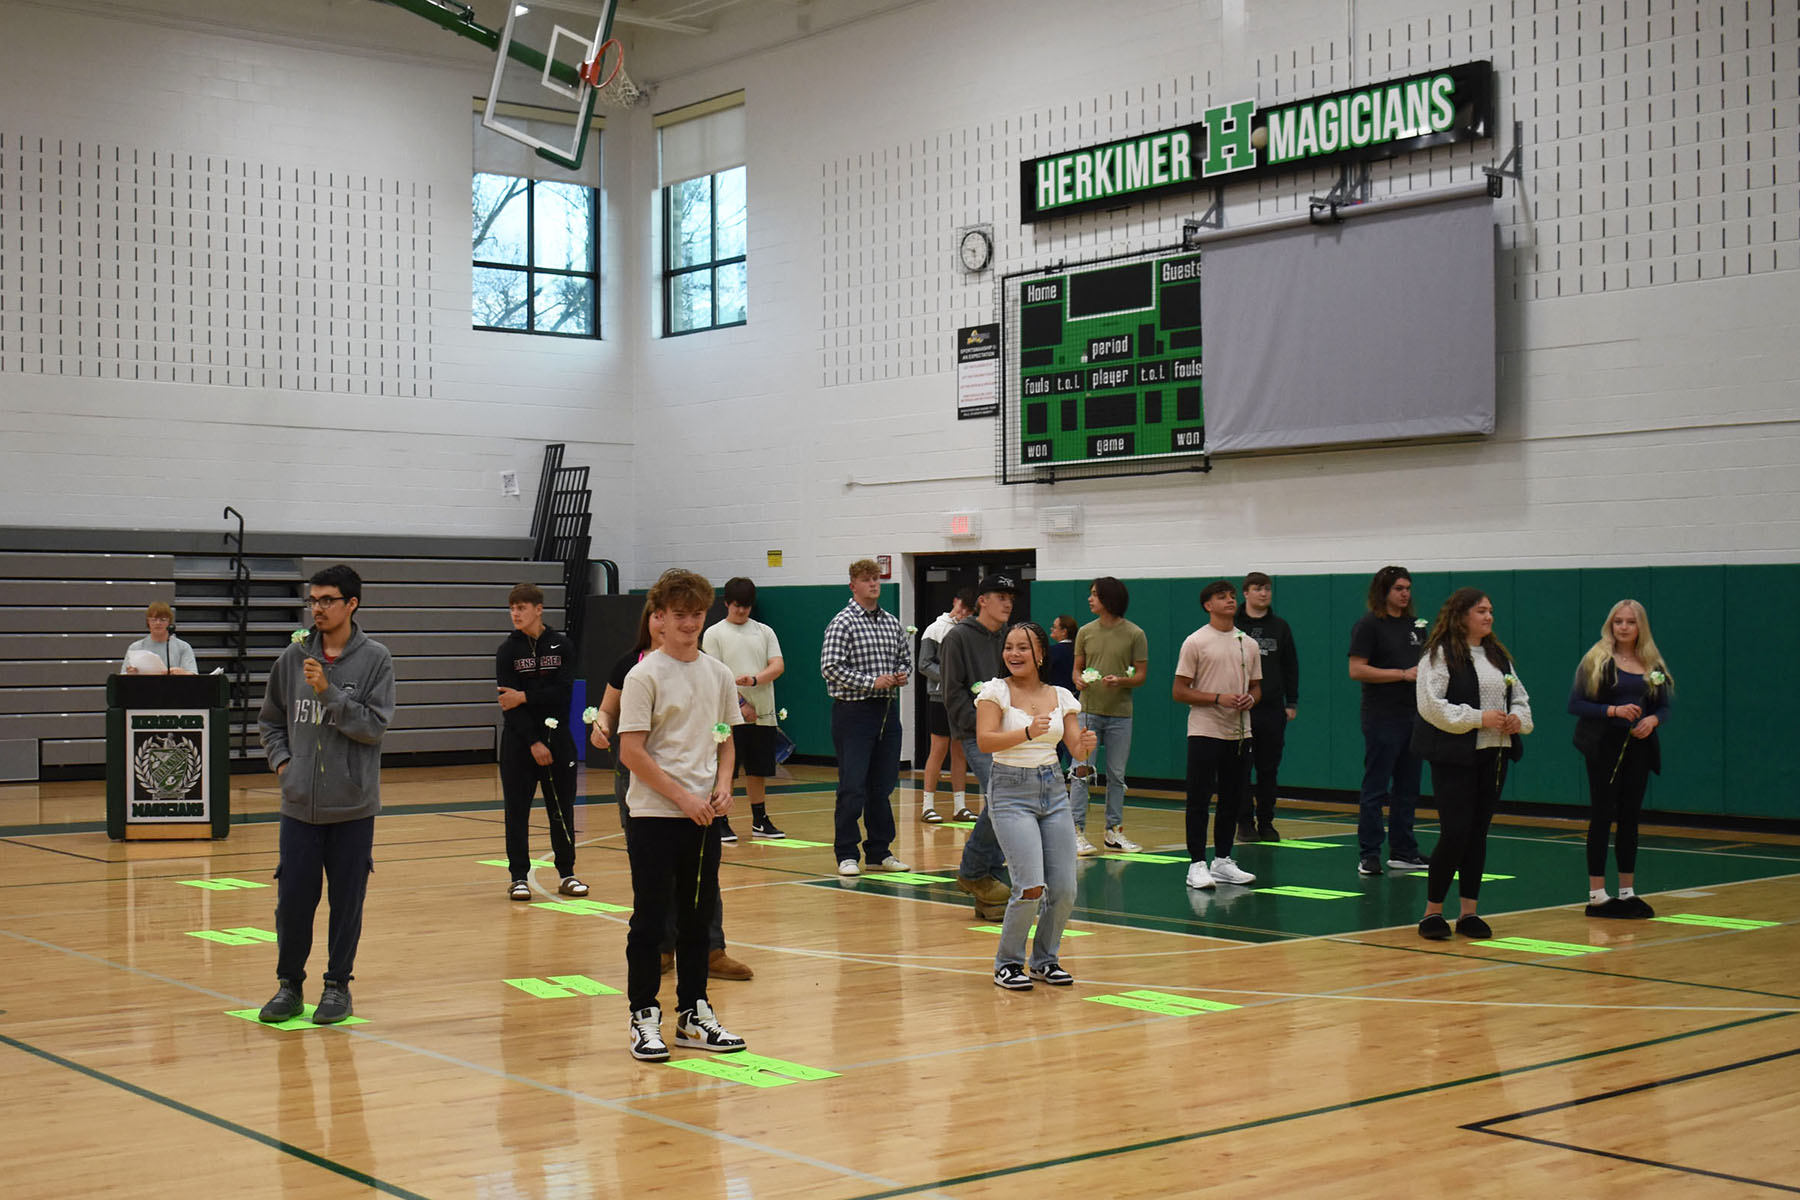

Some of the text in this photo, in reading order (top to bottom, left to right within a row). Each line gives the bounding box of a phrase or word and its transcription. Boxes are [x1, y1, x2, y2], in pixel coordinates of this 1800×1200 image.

[1036, 74, 1456, 211] HERKIMER H MAGICIANS
[1027, 260, 1203, 302] Home Guests
[1092, 336, 1129, 359] period
[1025, 376, 1050, 395] fouls
[1092, 368, 1129, 389] player
[1174, 360, 1202, 378] fouls
[1027, 432, 1200, 457] won game won
